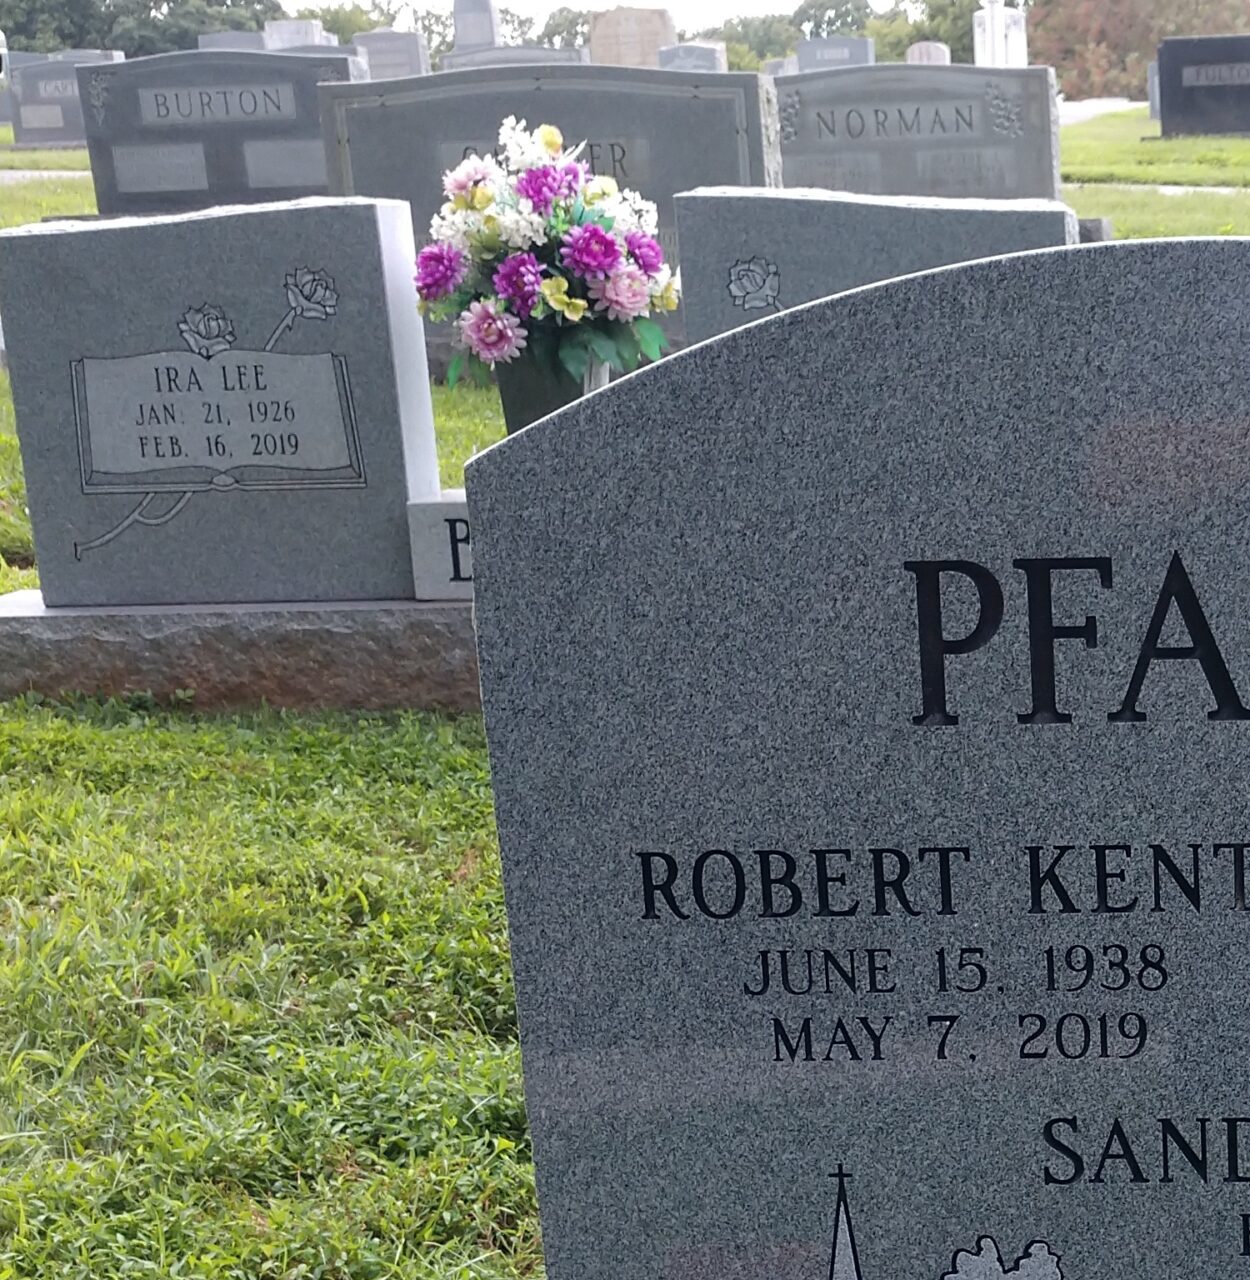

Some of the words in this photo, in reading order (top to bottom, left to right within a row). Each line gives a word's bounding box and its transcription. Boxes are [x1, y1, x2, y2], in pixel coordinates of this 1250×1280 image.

[153, 88, 282, 119] BURTON
[816, 105, 974, 140] NORMAN
[153, 365, 204, 393] IRA
[221, 364, 268, 392] LEE
[135, 402, 185, 426] JAN.
[201, 401, 232, 427] 21,
[247, 400, 296, 423] 1926
[138, 435, 189, 459] FEB.
[205, 433, 234, 459] 16,
[250, 433, 300, 456] 2019
[634, 846, 972, 921] ROBERT
[743, 947, 898, 997] JUNE
[1044, 942, 1169, 993] 1938
[770, 1013, 895, 1062] MAY
[1018, 1011, 1149, 1060] 2019
